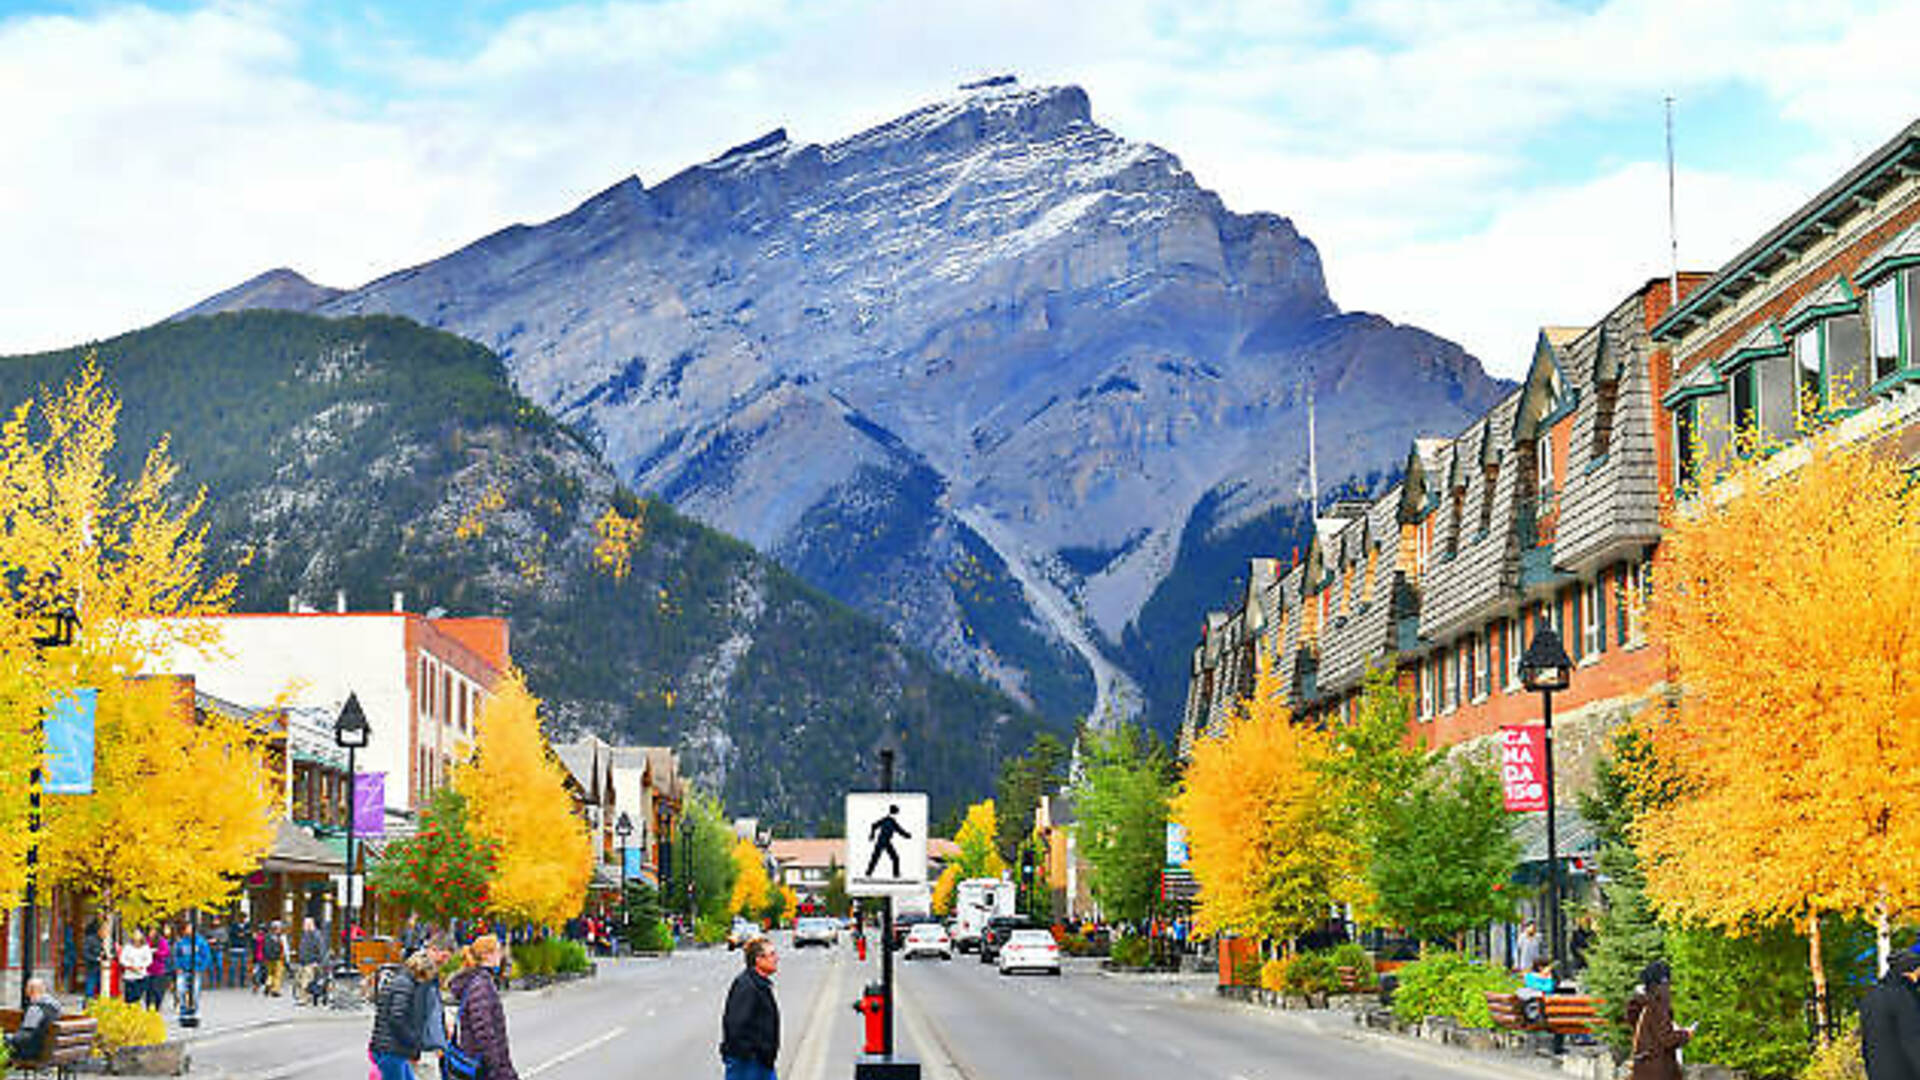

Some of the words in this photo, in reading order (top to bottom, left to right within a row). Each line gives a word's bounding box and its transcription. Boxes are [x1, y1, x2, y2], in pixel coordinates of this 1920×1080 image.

[1504, 730, 1531, 744] CA
[1504, 747, 1533, 763] NA
[1505, 765, 1533, 781] DA
[1506, 783, 1542, 799] 150
